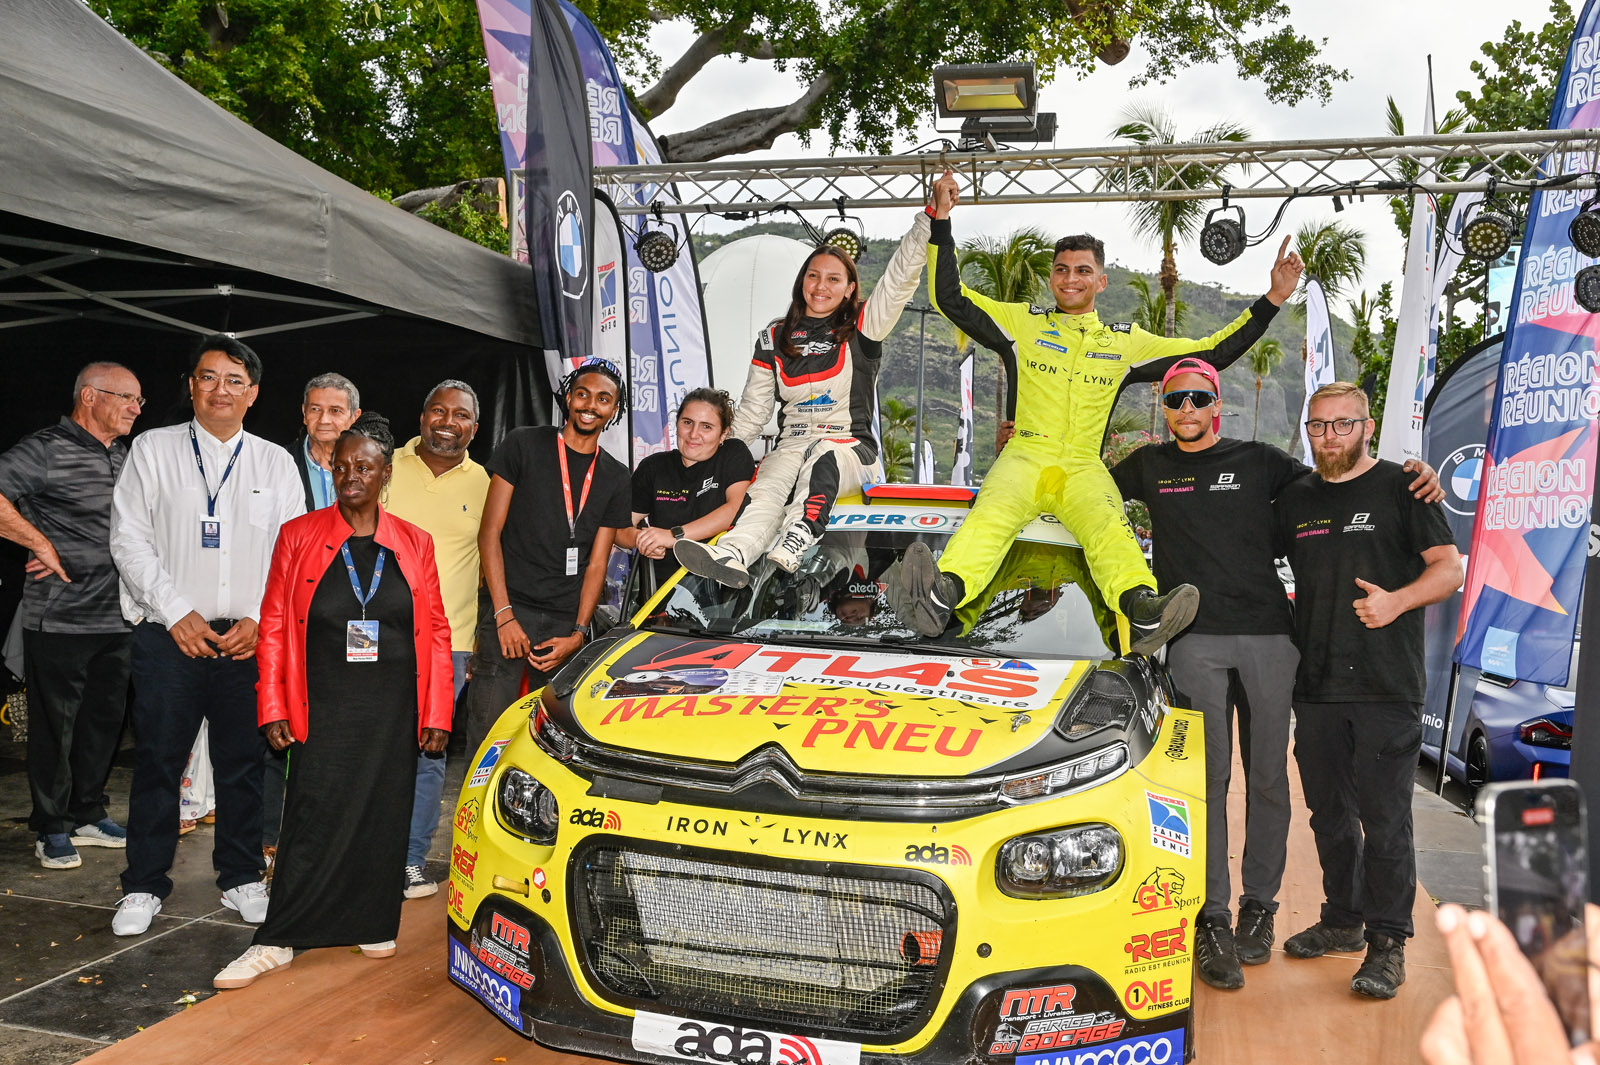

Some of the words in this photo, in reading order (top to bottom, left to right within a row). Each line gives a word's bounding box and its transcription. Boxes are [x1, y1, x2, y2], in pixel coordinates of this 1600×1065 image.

[1026, 360, 1058, 374] IRON
[1083, 374, 1114, 387] LYNX
[1500, 386, 1600, 429] RÉUNIO
[1452, 447, 1486, 465] BM
[1487, 456, 1586, 497] RÉGION
[829, 514, 907, 525] YPER
[1485, 494, 1593, 530] RÉUNIO
[632, 642, 1040, 698] ATLAS
[600, 695, 893, 726] MASTER'S
[801, 718, 983, 758] PNEU
[569, 807, 605, 829] ada
[666, 816, 729, 837] IRON
[783, 828, 848, 849] LYNX
[1153, 826, 1189, 843] SAINT
[1153, 837, 1189, 855] DENIS
[904, 843, 950, 865] ada
[1173, 895, 1201, 911] Sport
[1130, 923, 1188, 963] RER
[478, 948, 536, 991] BOCAGE
[1125, 966, 1146, 975] RADIO
[1149, 963, 1161, 971] EST
[1163, 956, 1191, 968] RÉUNION
[1000, 1014, 1037, 1022] Transport
[1043, 1009, 1075, 1018] Livraison
[1147, 1001, 1174, 1011] FITNESS
[1174, 997, 1190, 1006] CLUB
[1018, 1019, 1126, 1052] BOCAGE
[1023, 1013, 1096, 1034] GARAGE
[674, 1021, 772, 1065] ada
